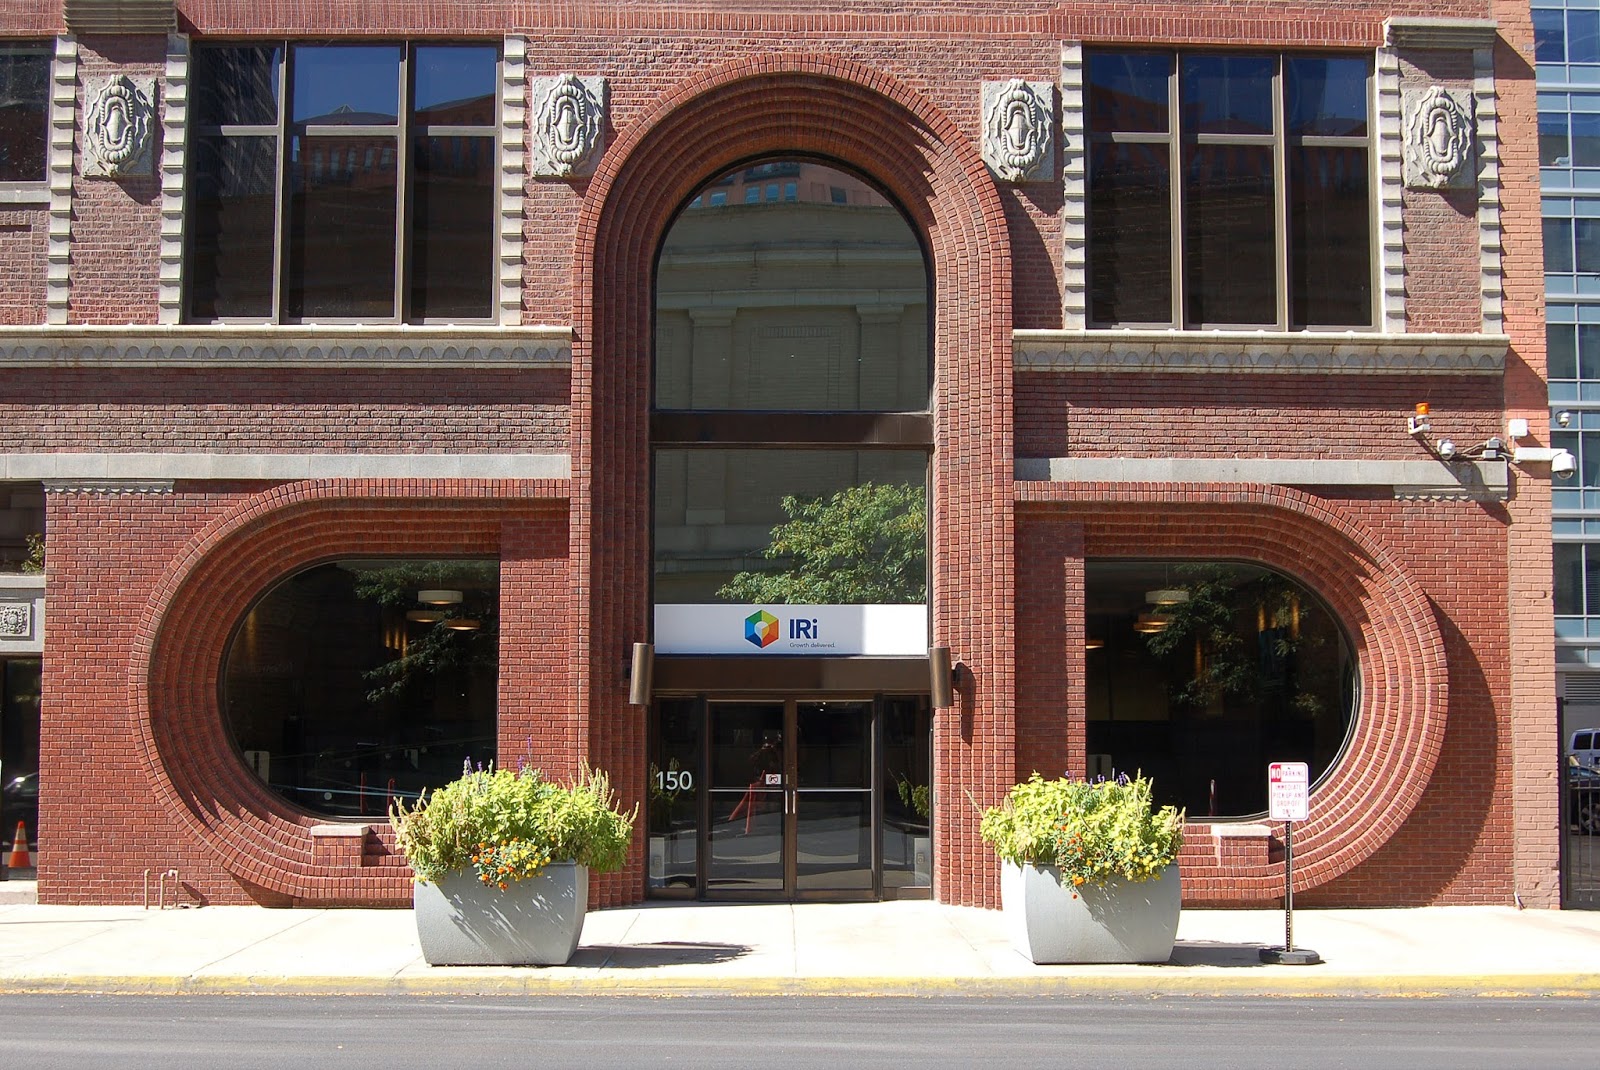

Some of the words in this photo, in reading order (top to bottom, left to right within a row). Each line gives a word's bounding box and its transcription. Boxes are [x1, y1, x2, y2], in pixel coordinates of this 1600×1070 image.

[790, 618, 818, 639] IRi
[655, 770, 693, 790] 150
[1271, 768, 1281, 779] NO
